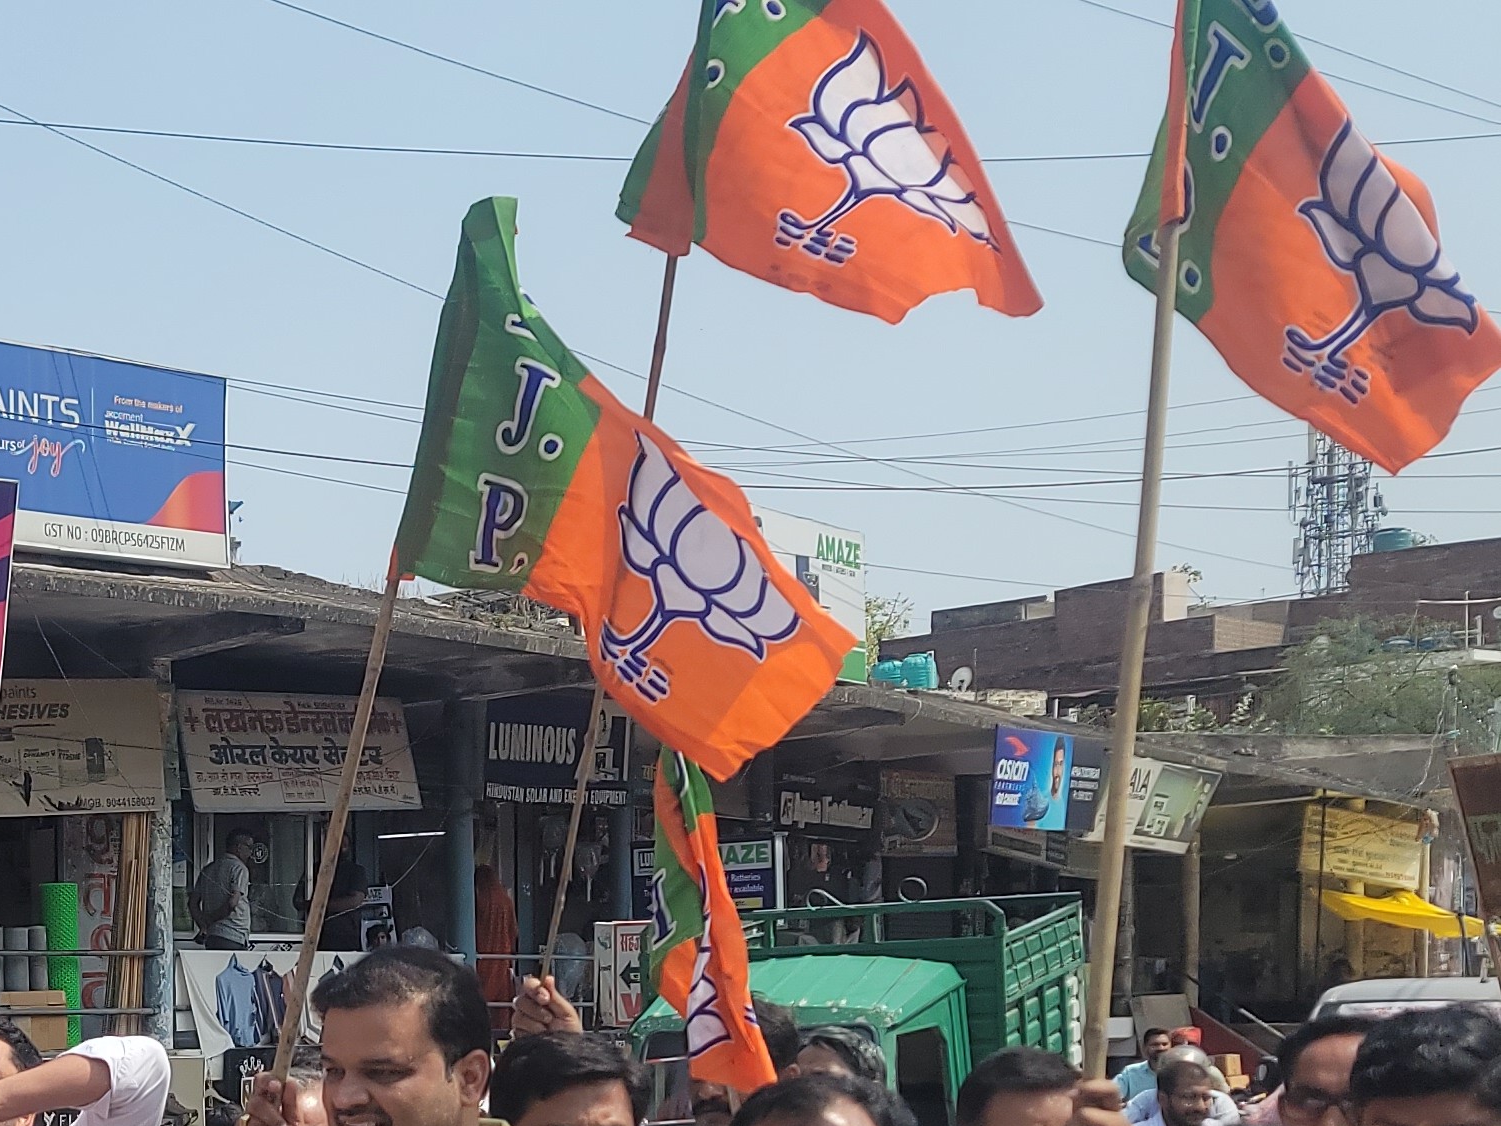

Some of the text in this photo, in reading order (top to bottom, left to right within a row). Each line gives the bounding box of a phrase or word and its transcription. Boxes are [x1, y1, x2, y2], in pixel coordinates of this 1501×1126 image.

[43, 522, 64, 538] GST
[67, 525, 82, 541] NO
[817, 533, 861, 570] AMAZE
[489, 722, 577, 766] LUMINOUS
[997, 758, 1030, 781] asian
[486, 782, 525, 803] HINDUSTAN
[526, 787, 548, 803] SOLAR
[549, 788, 563, 803] AND
[590, 790, 628, 805] EQUIPMENT
[724, 843, 769, 864] AZE
